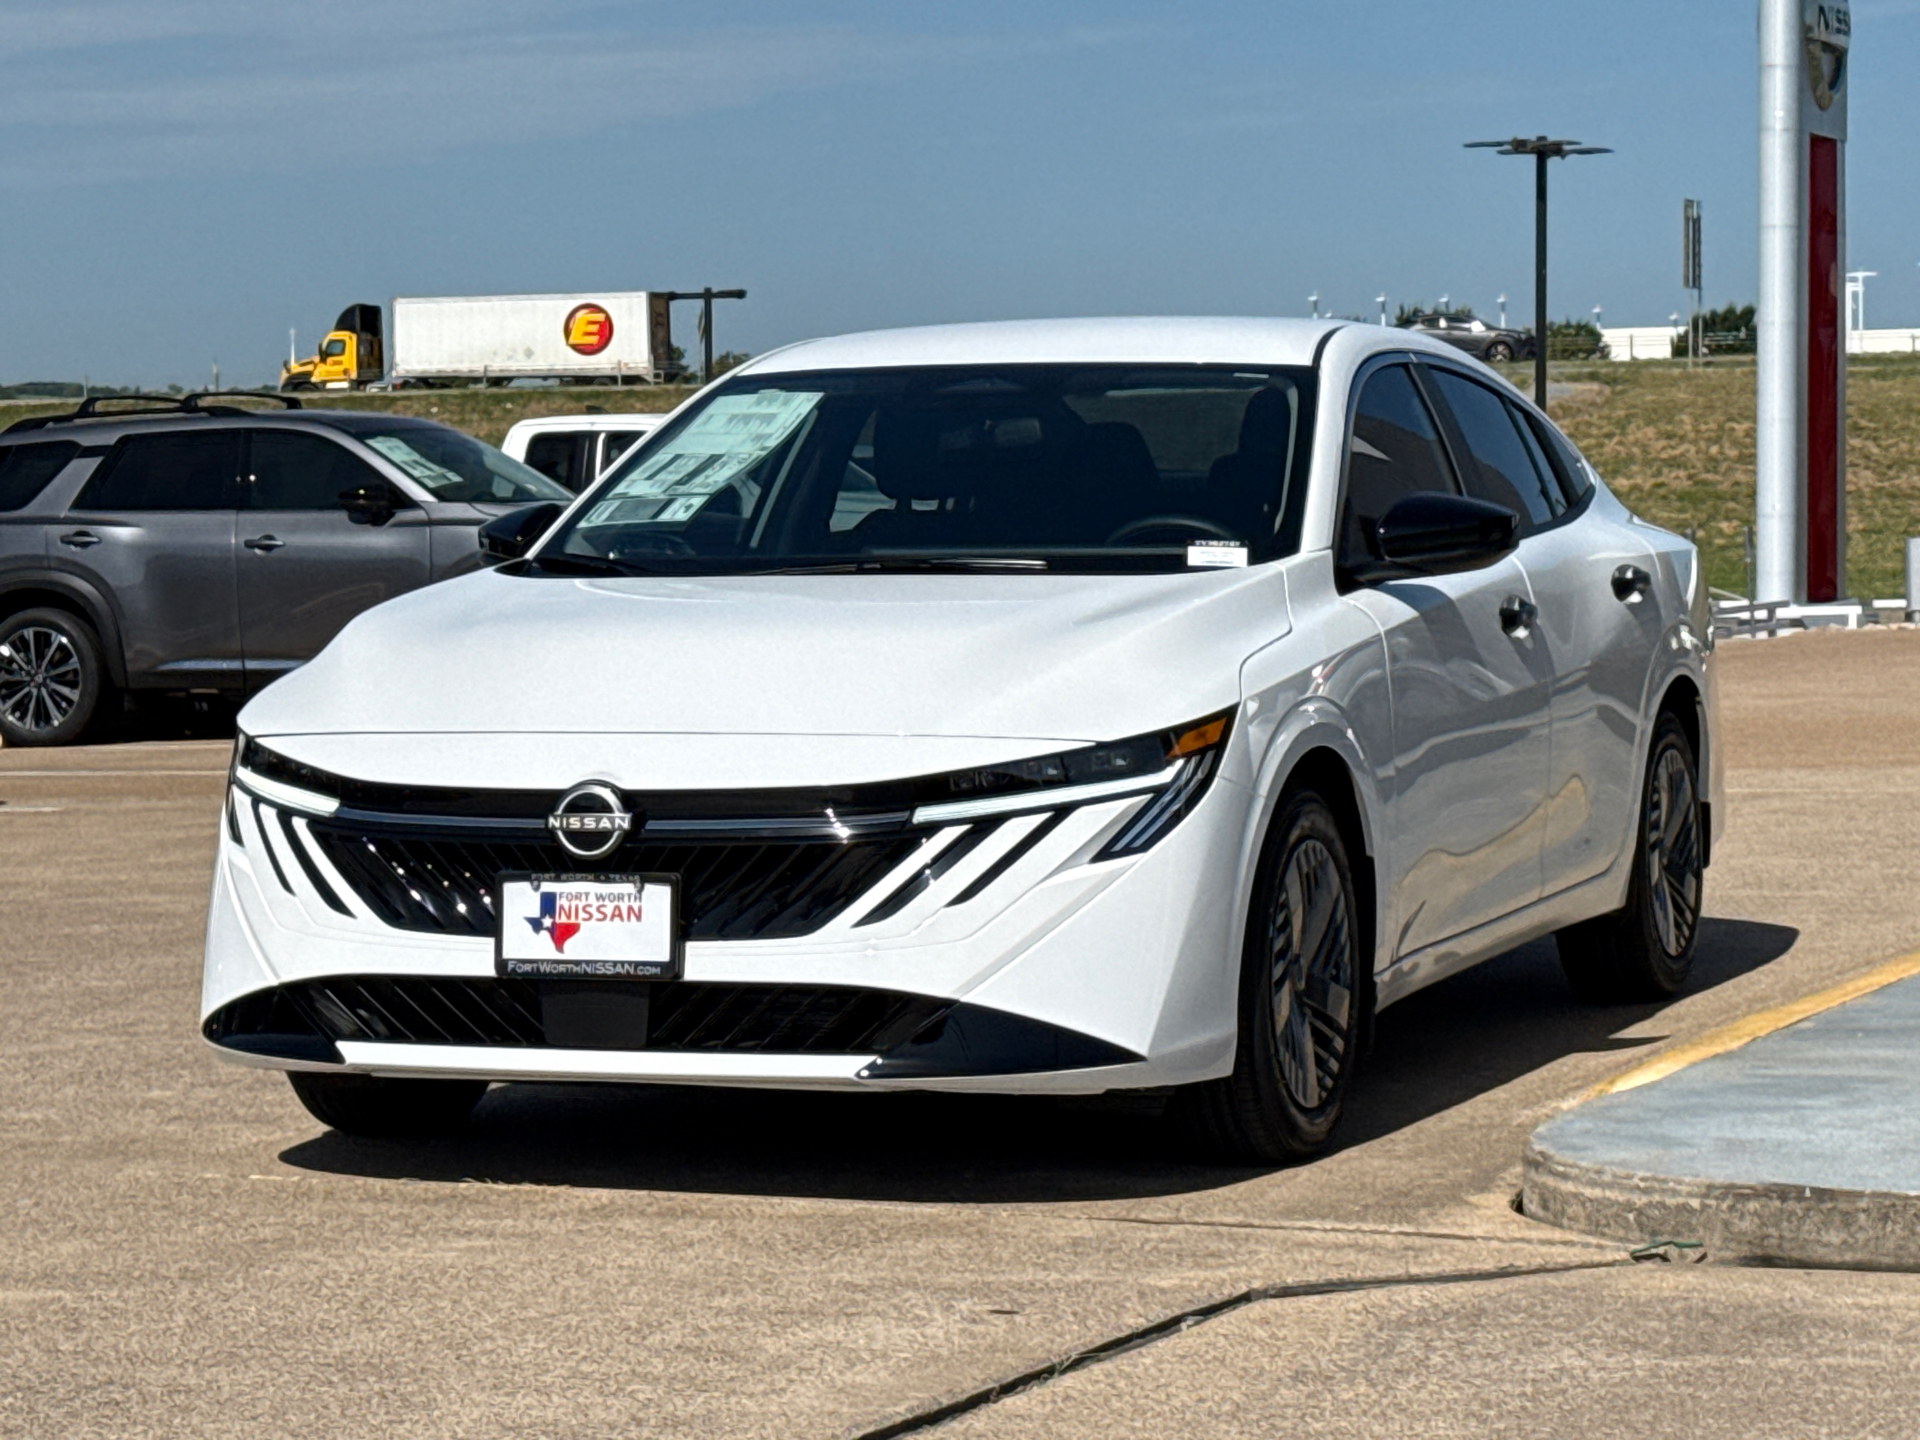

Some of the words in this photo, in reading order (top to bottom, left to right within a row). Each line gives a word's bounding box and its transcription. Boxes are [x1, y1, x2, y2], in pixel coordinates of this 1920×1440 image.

[568, 309, 606, 345] E
[548, 815, 630, 830] NISSAN
[531, 872, 556, 881] FORT
[560, 872, 595, 881] WORTH
[558, 891, 591, 903] FORT
[594, 891, 643, 904] WORTH
[557, 903, 643, 923] NISSAN
